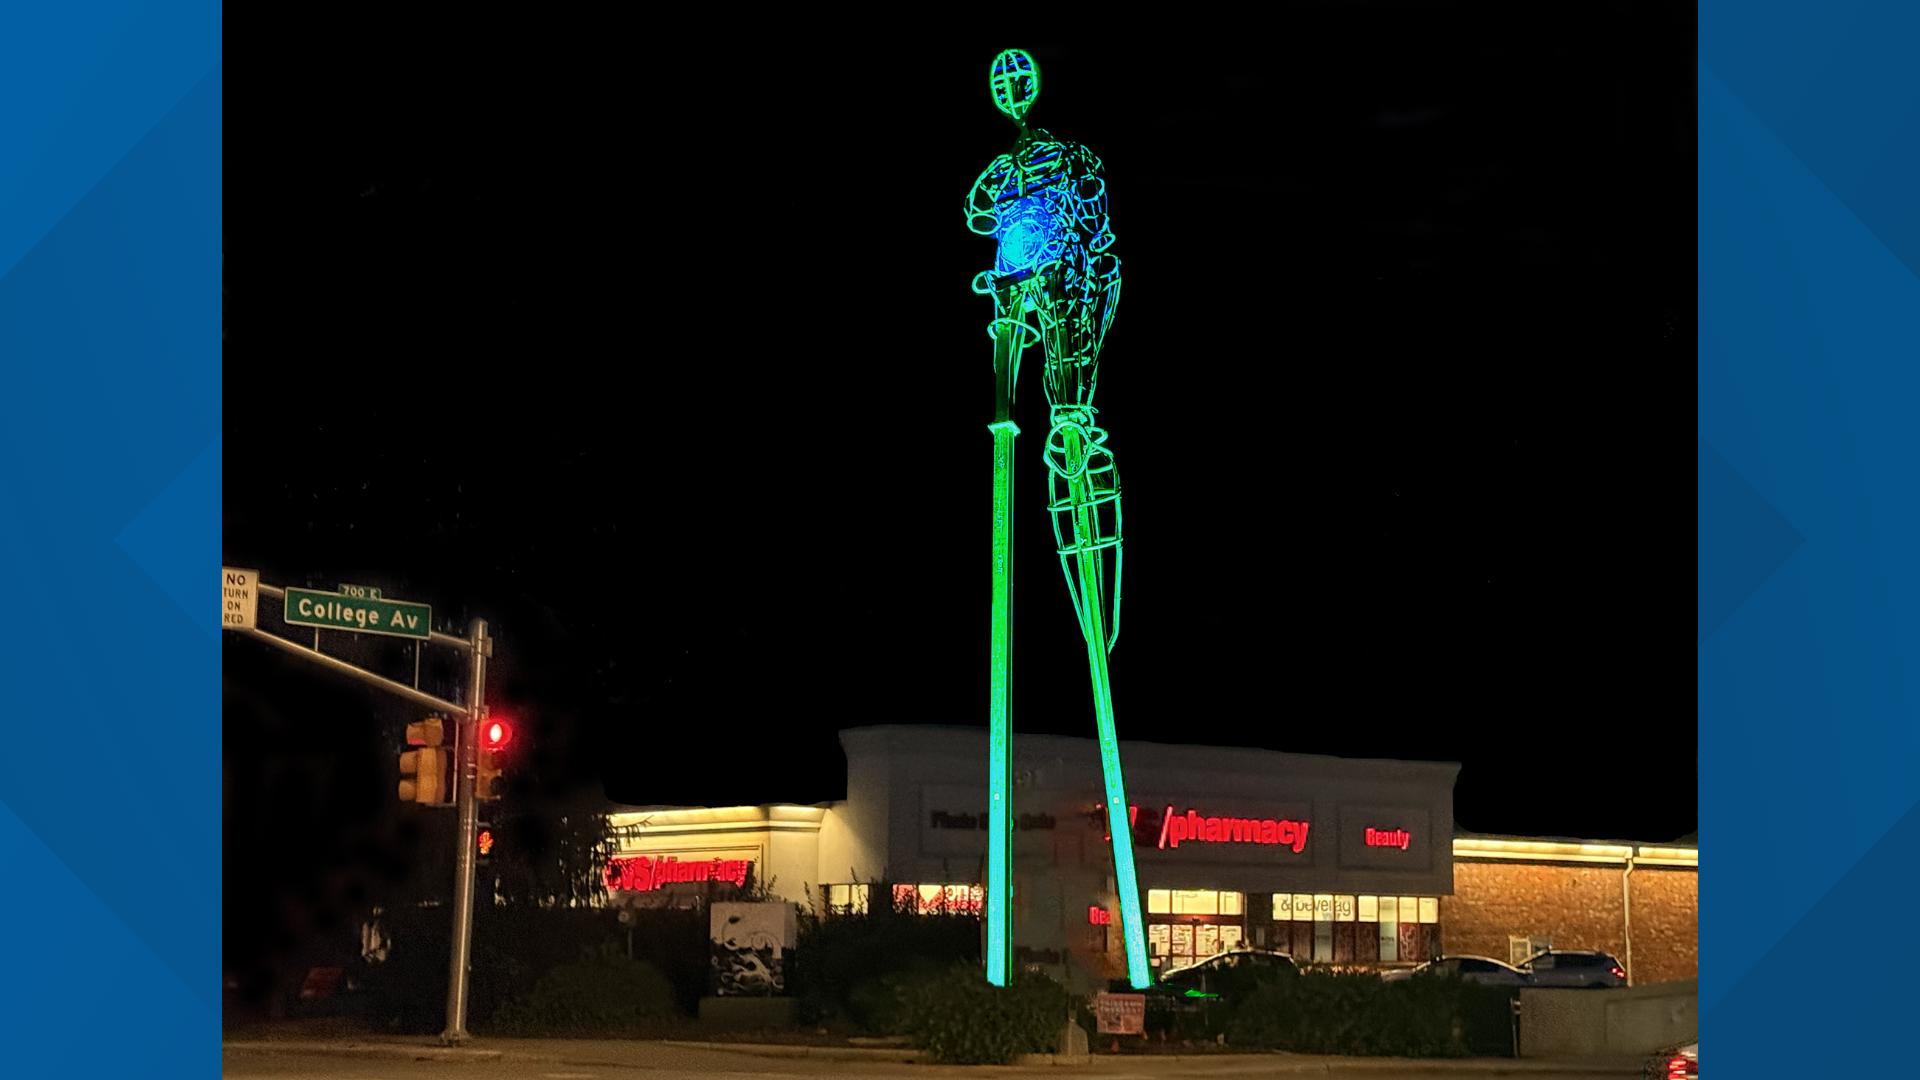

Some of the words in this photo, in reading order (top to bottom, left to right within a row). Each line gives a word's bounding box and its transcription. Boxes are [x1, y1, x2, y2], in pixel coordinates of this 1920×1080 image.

[226, 573, 246, 586] NO
[223, 587, 248, 599] TURN
[343, 586, 365, 597] 700
[369, 589, 378, 600] E
[227, 600, 241, 611] ON
[224, 613, 243, 624] RED
[299, 598, 380, 628] College
[390, 610, 418, 629] Av
[1096, 804, 1309, 853] /pharmacy
[1365, 828, 1410, 850] Beauty
